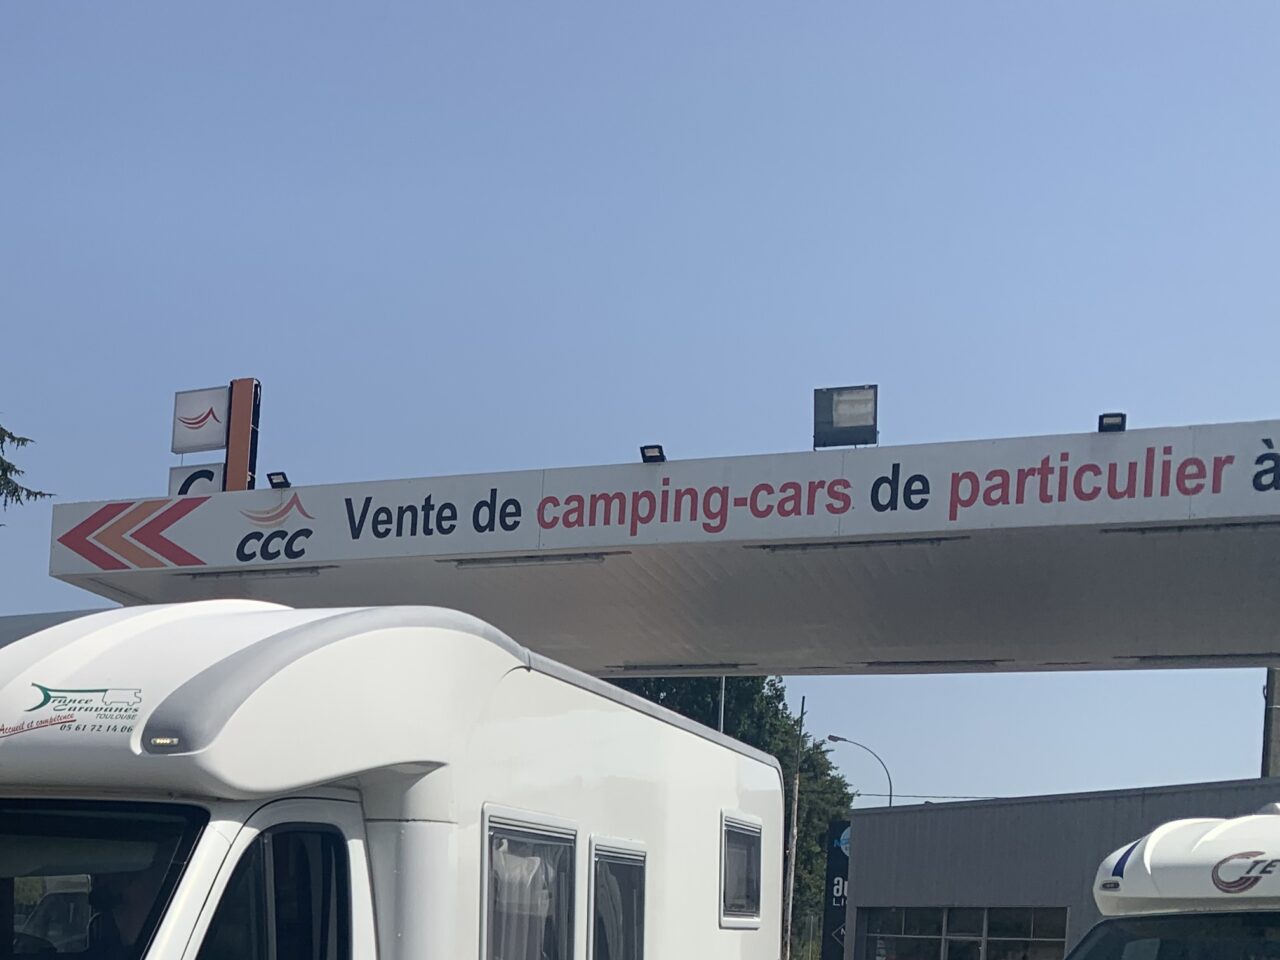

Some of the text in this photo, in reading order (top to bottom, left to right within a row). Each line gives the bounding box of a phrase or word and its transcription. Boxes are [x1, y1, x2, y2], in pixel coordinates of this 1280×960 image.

[344, 438, 1280, 540] Vente de camping-cars de particulier à
